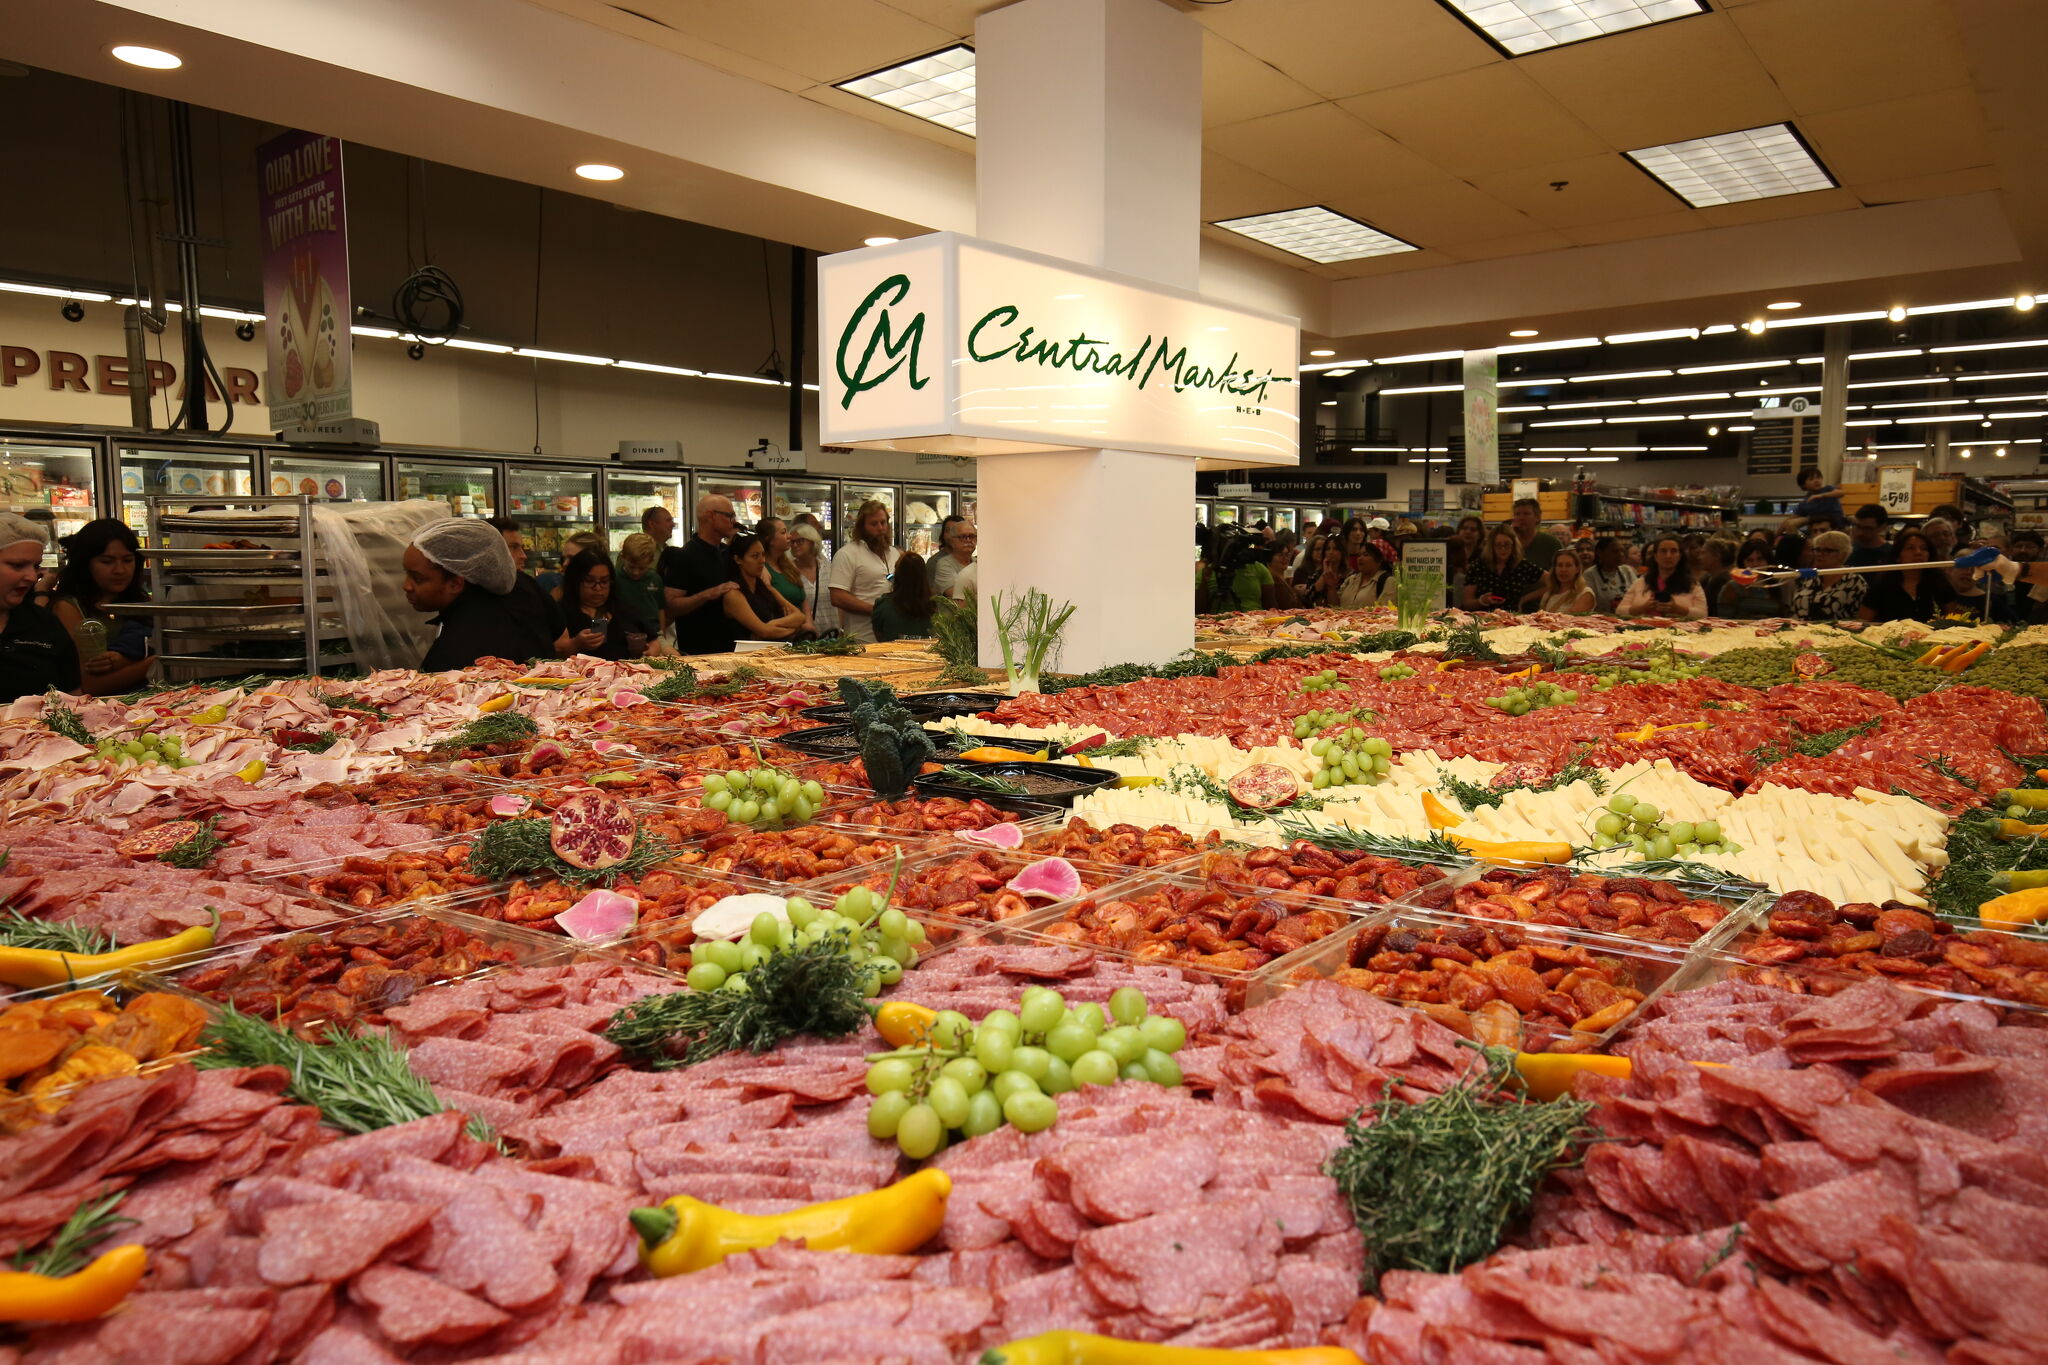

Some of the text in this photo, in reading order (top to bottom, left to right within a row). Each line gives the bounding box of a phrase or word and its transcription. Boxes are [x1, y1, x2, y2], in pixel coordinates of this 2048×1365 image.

[265, 136, 333, 196] OUR LOVE
[303, 180, 326, 198] BETTER
[268, 191, 336, 252] WITH AGE
[967, 305, 1293, 404] Central Market
[272, 405, 301, 423] CELEBRATING
[302, 400, 317, 421] 30
[1794, 402, 1804, 410] 11
[1259, 481, 1316, 489] SMOOTHIES
